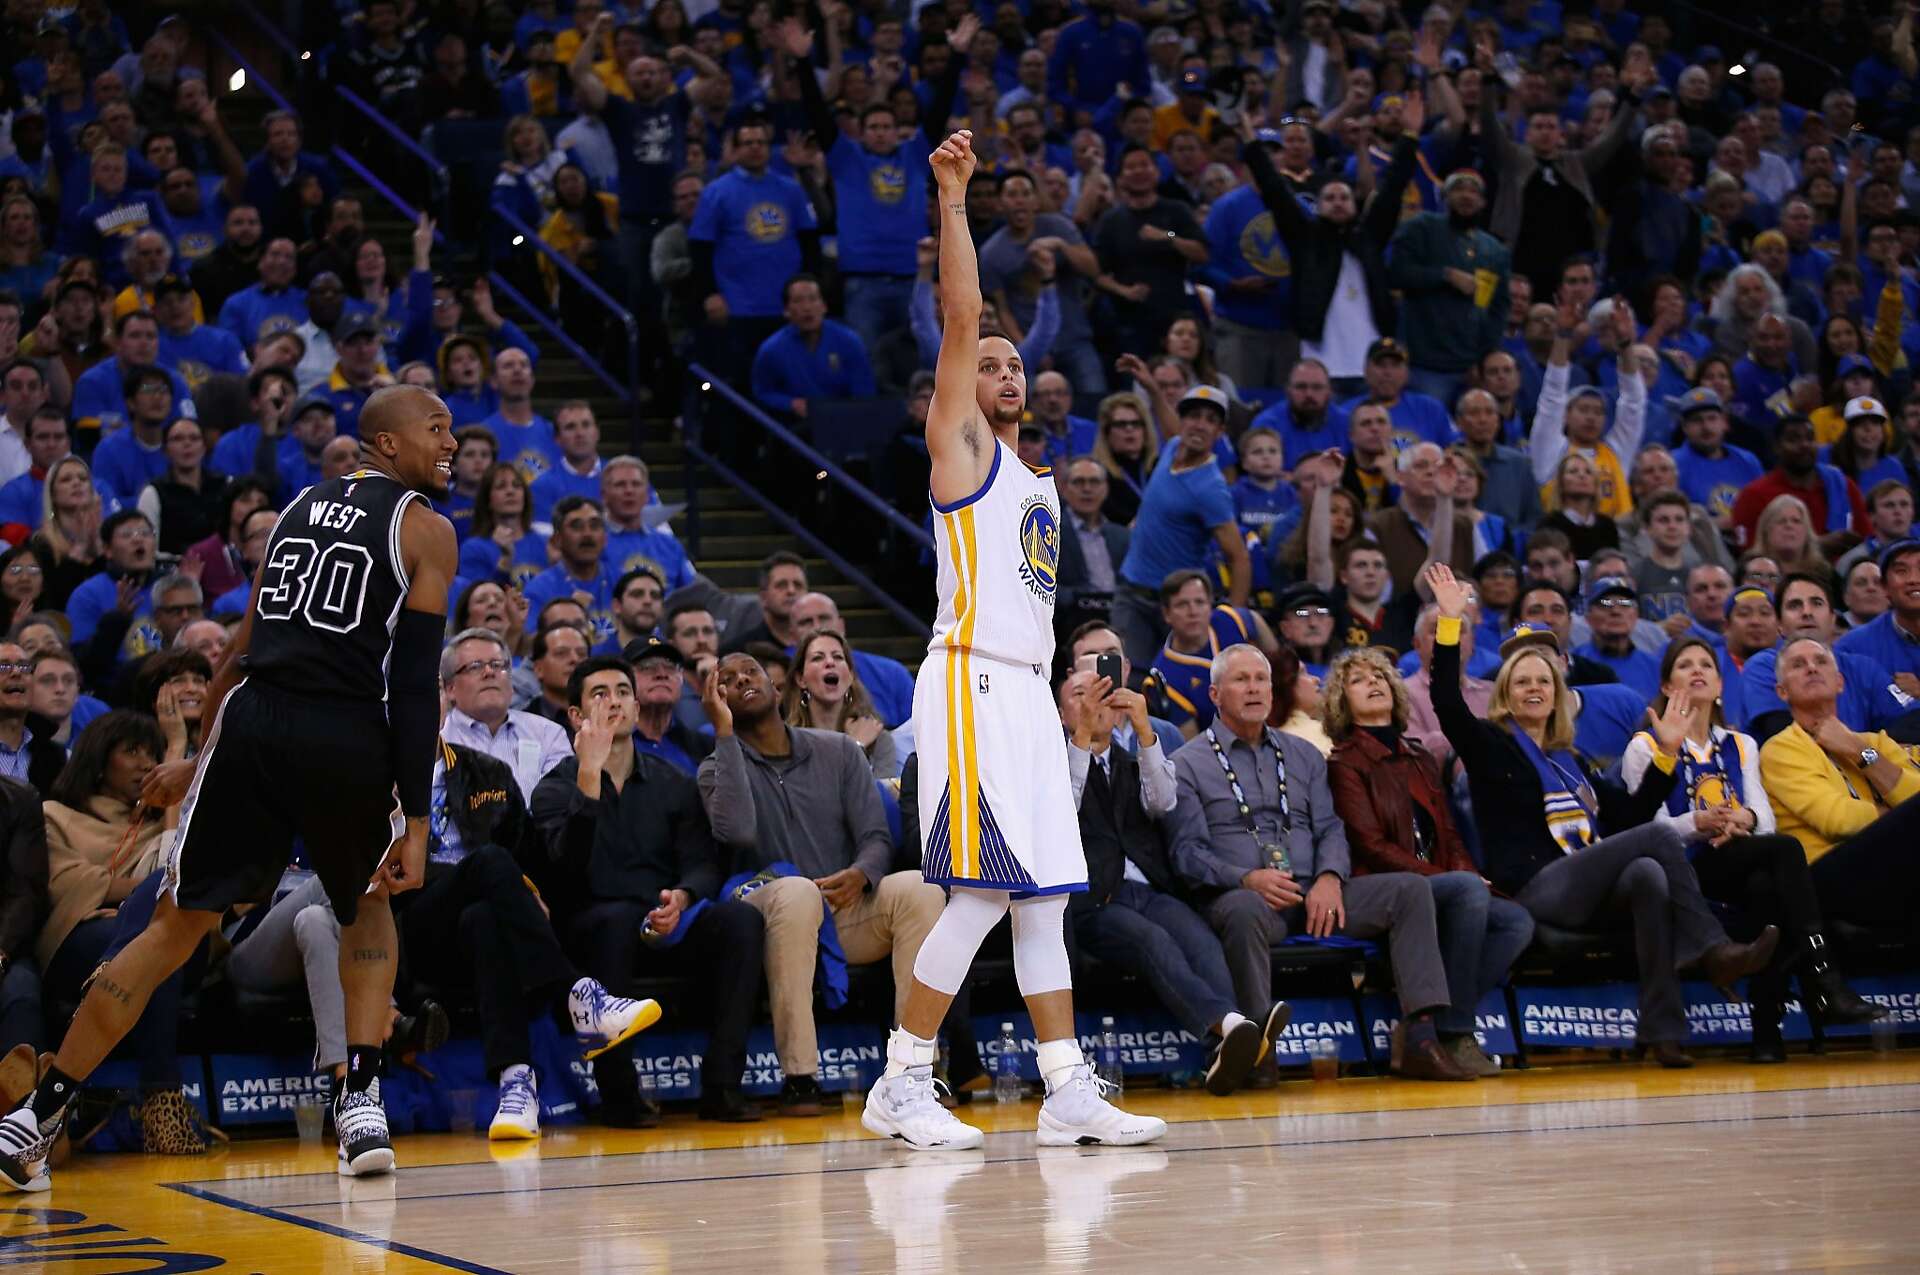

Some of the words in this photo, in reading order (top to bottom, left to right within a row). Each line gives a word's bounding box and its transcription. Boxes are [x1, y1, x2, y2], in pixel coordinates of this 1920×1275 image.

[308, 501, 367, 533] WEST
[257, 537, 374, 634] 30
[469, 789, 507, 810] Warriors
[1524, 1004, 1638, 1021] AMERICA
[1280, 1021, 1354, 1038] RICAN
[1525, 1020, 1636, 1038] EXPRESS
[1081, 1030, 1199, 1048] MERICAN
[1276, 1038, 1335, 1054] RESS
[223, 1075, 331, 1094] AMERIC
